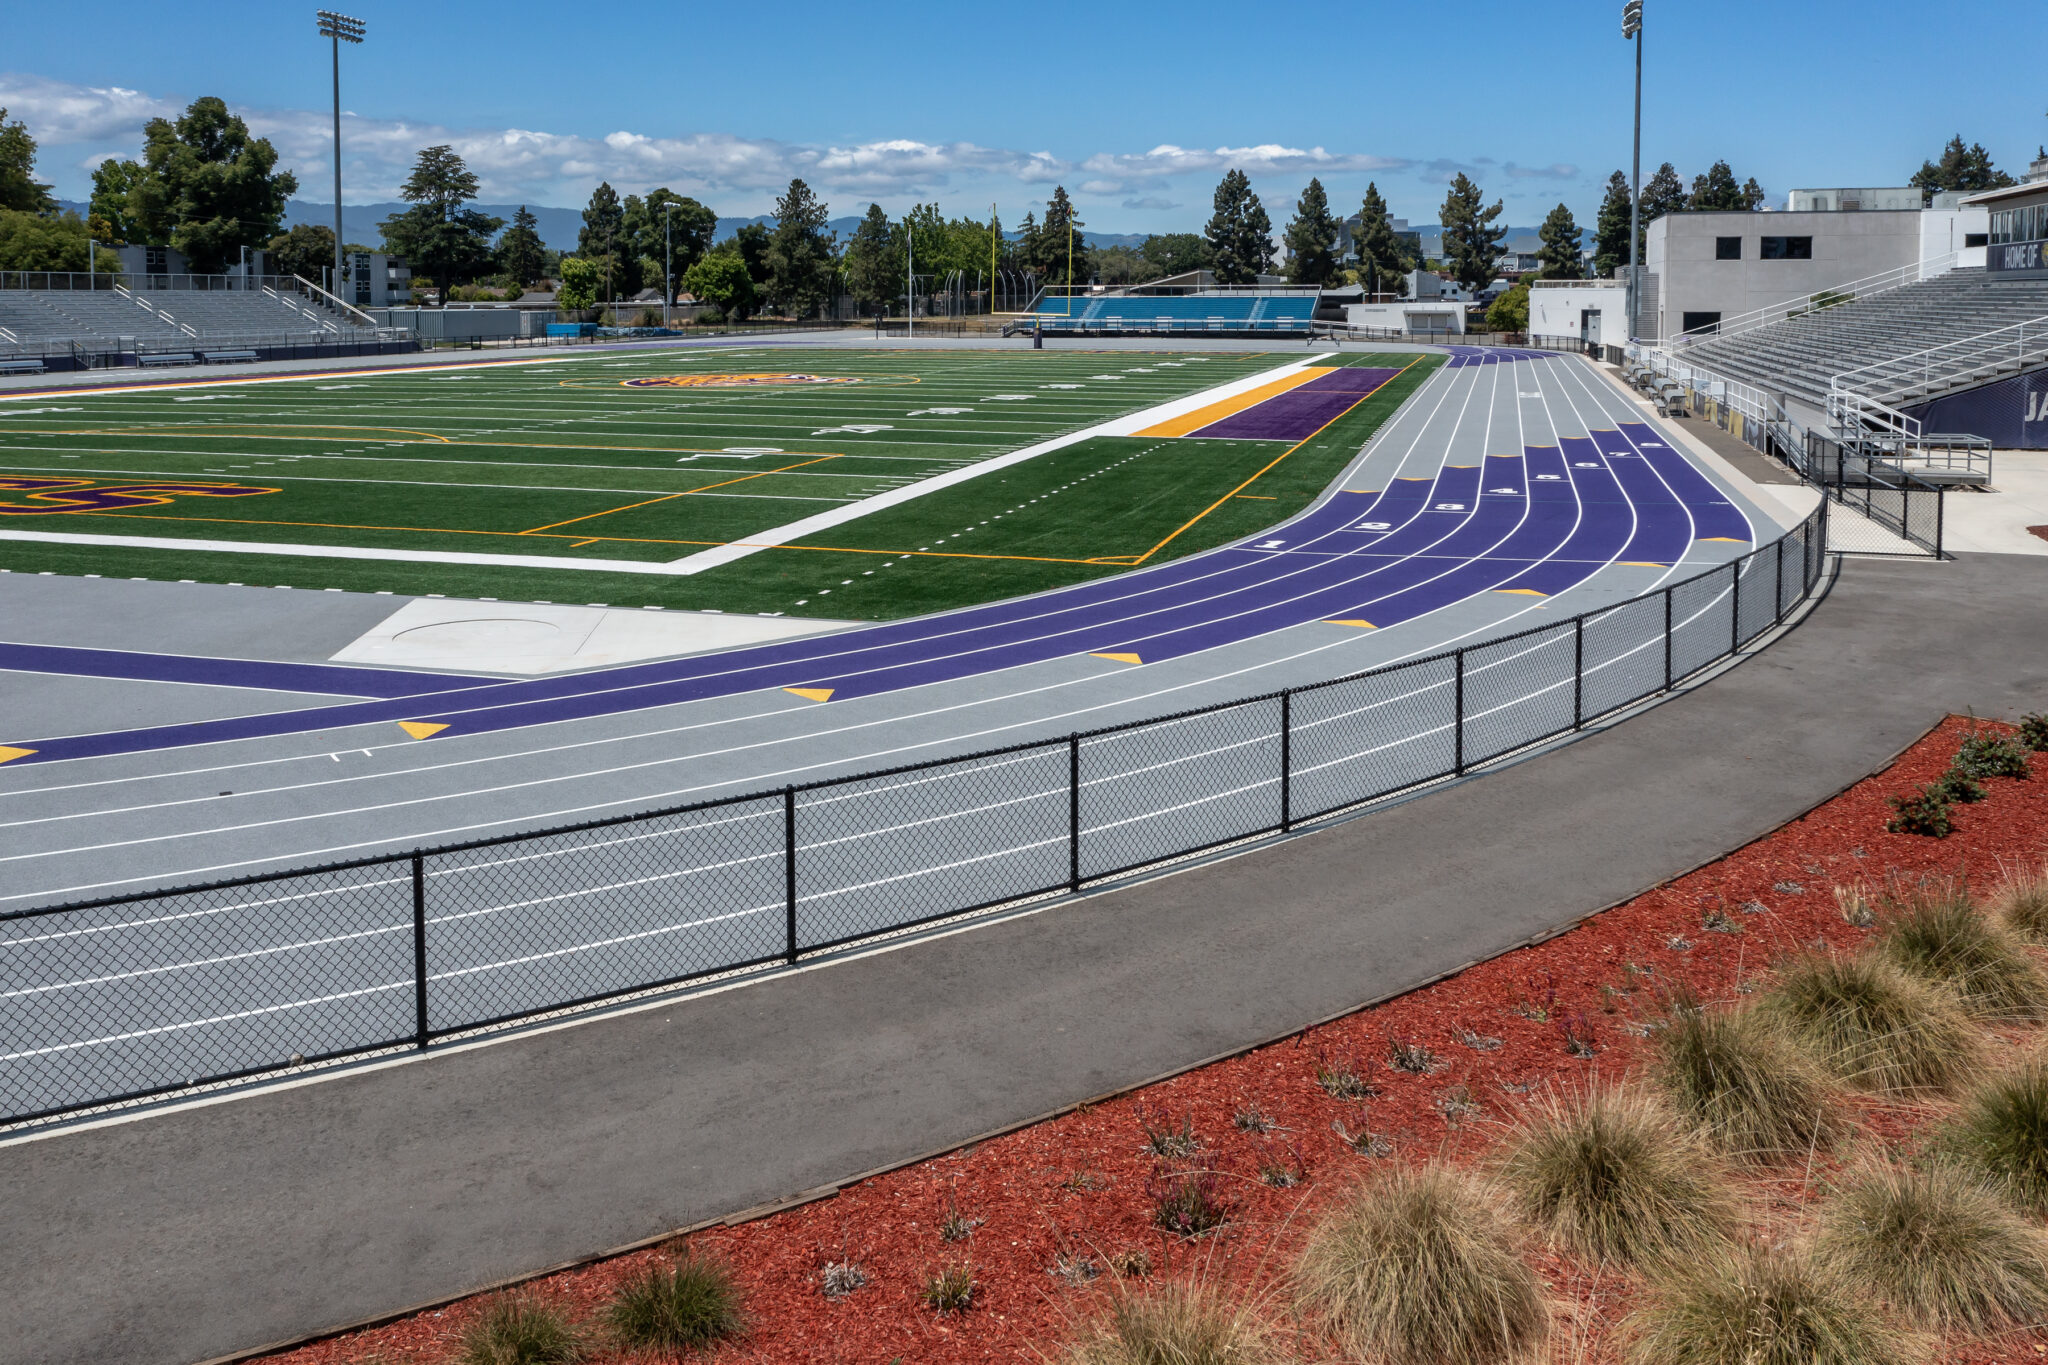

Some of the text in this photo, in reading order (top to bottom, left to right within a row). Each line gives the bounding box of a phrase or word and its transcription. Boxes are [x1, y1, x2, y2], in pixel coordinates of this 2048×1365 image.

[2004, 244, 2038, 269] HOME OF
[1354, 521, 1392, 530] 2
[1253, 539, 1287, 549] 1
